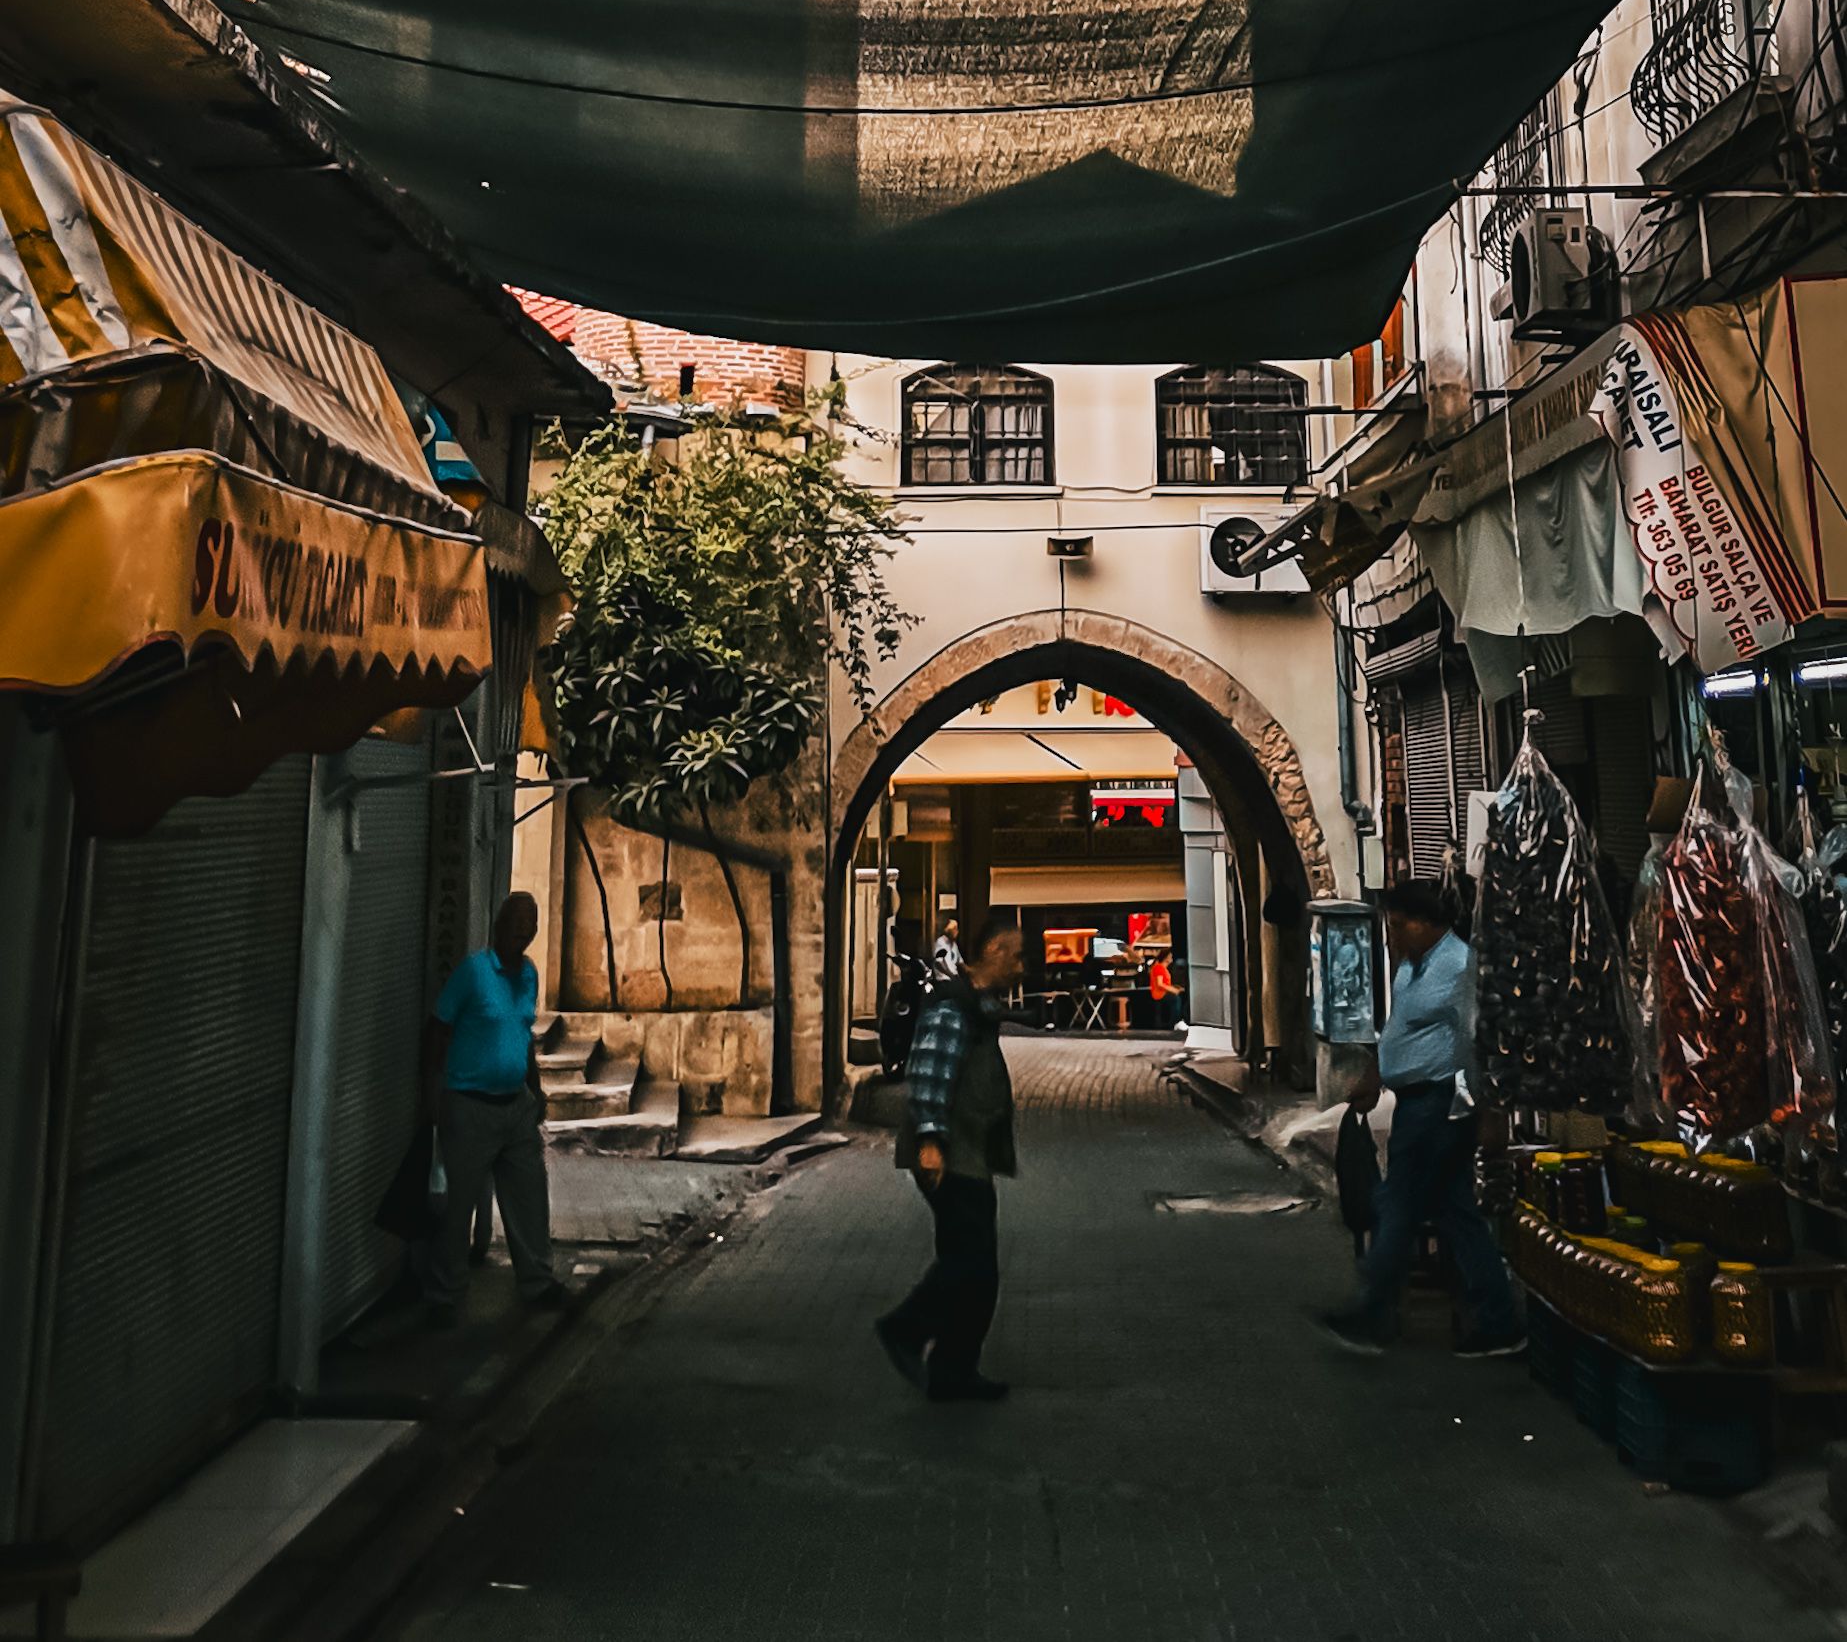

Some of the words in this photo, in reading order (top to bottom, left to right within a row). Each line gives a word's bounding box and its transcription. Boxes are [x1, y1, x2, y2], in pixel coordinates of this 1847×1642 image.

[1613, 339, 1682, 453] ARAİSALI
[1647, 519, 1676, 552] 363
[1658, 475, 1713, 557] BAHARAT
[1699, 559, 1738, 613] SATIŞ
[1724, 612, 1764, 659] YERİ
[1663, 553, 1688, 577] 05
[1686, 465, 1734, 540] BULGUR
[1720, 538, 1761, 599] SALÇA
[1749, 596, 1775, 626] VE
[1674, 578, 1700, 601] 69
